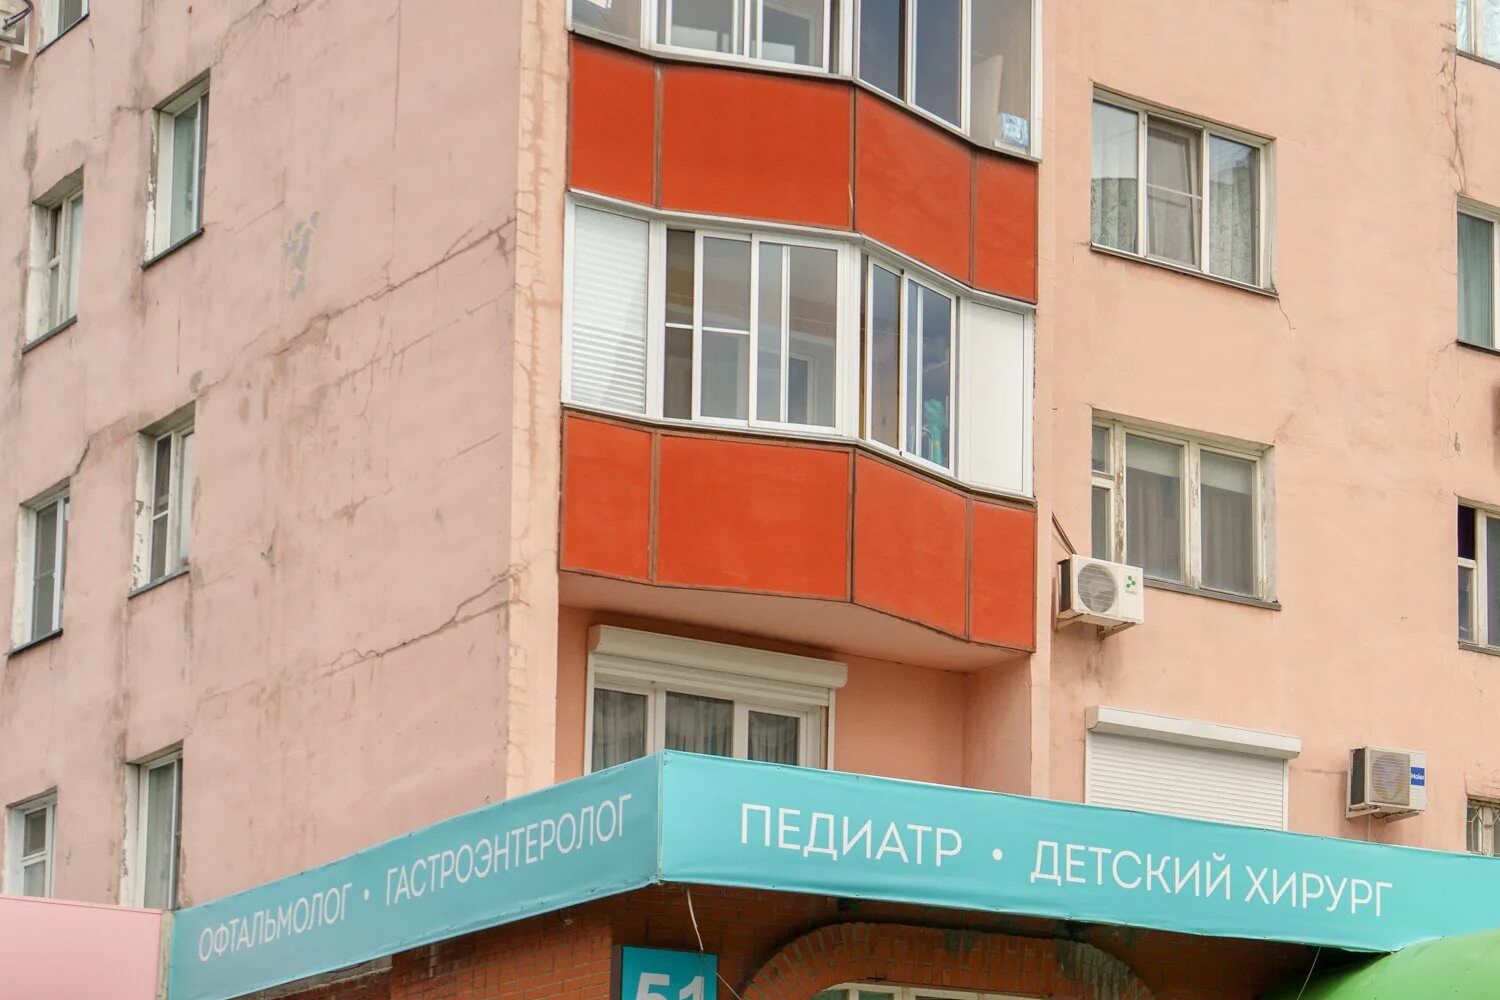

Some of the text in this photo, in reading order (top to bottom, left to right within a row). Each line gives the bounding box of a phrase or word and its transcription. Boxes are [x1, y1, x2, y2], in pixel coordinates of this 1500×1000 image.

[740, 803, 962, 867] ПЕДИАТР
[198, 794, 632, 962] ОФТАЛЬМОЛОГ ГАСТРОЭНТЕРОЛОГ
[1030, 840, 1393, 917] ДЕТСКИЙ ХИРУРГ
